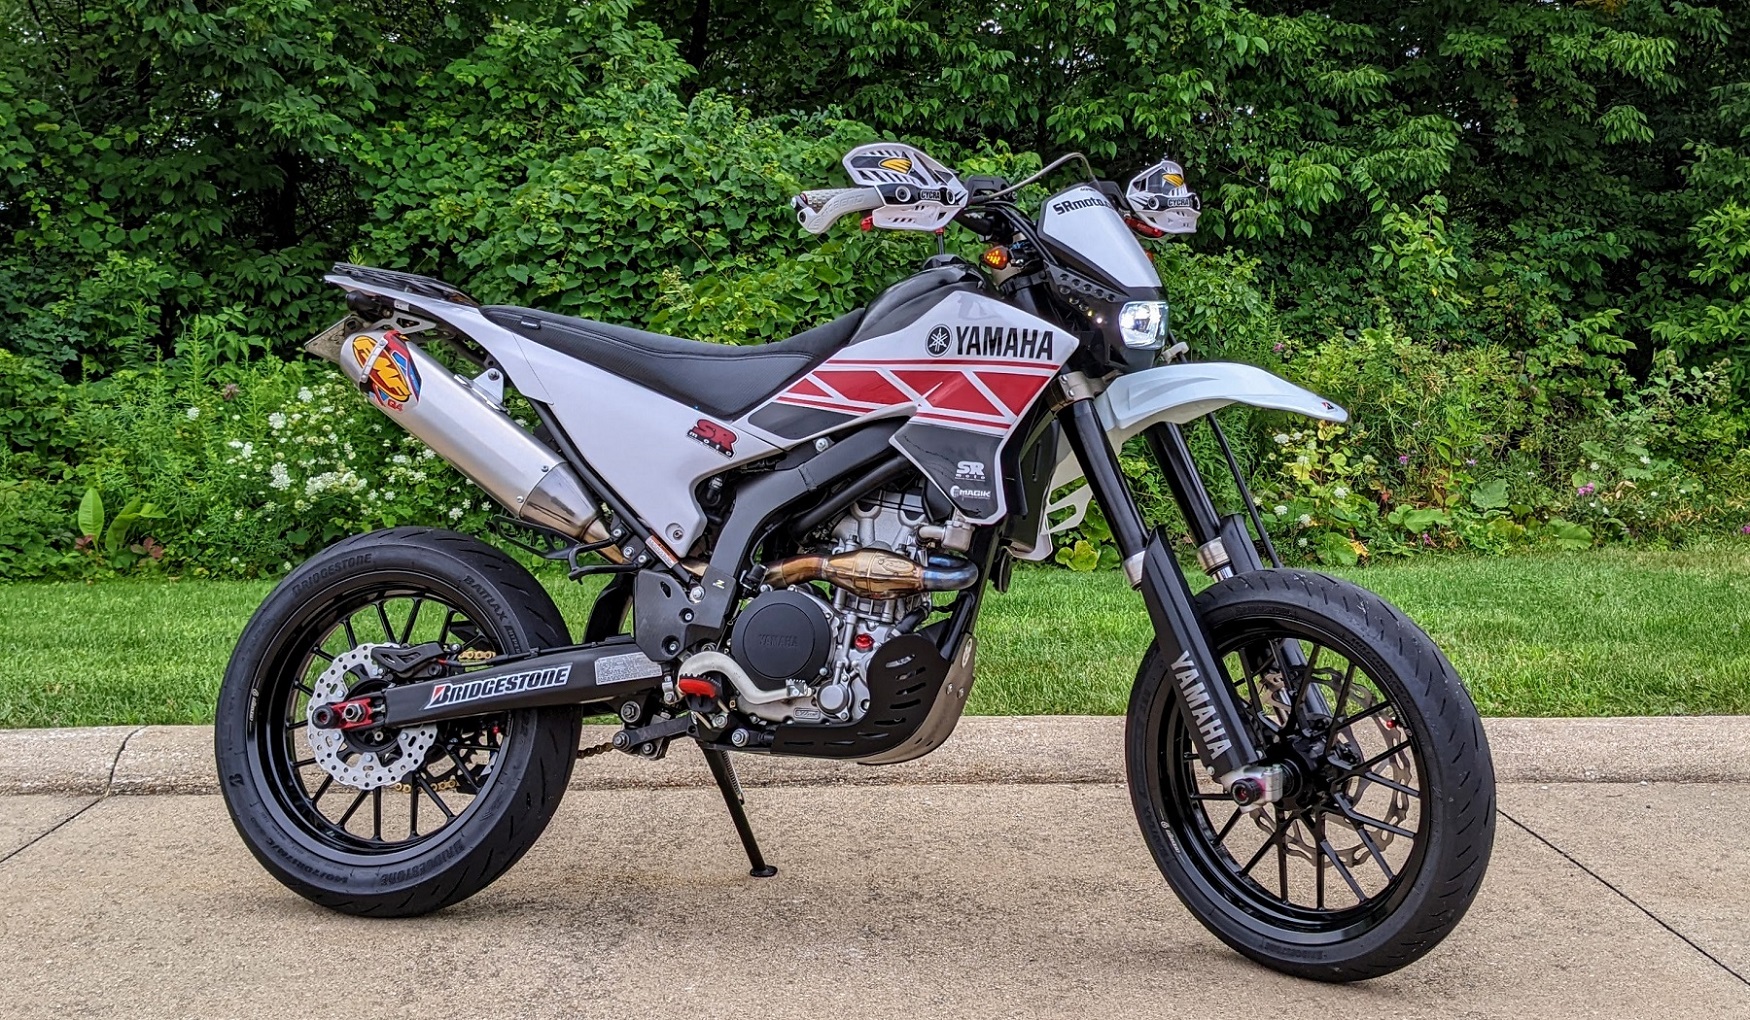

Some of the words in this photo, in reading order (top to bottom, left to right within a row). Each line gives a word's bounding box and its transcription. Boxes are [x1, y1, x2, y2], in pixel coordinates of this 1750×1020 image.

[1168, 198, 1190, 206] CYCRA
[956, 326, 1054, 360] YAMAHA
[691, 418, 738, 452] SR
[956, 460, 985, 476] SR
[291, 553, 373, 598] BRIDGESTONE
[429, 667, 570, 707] BRIDGESTONE
[1170, 650, 1232, 760] YAMAHA
